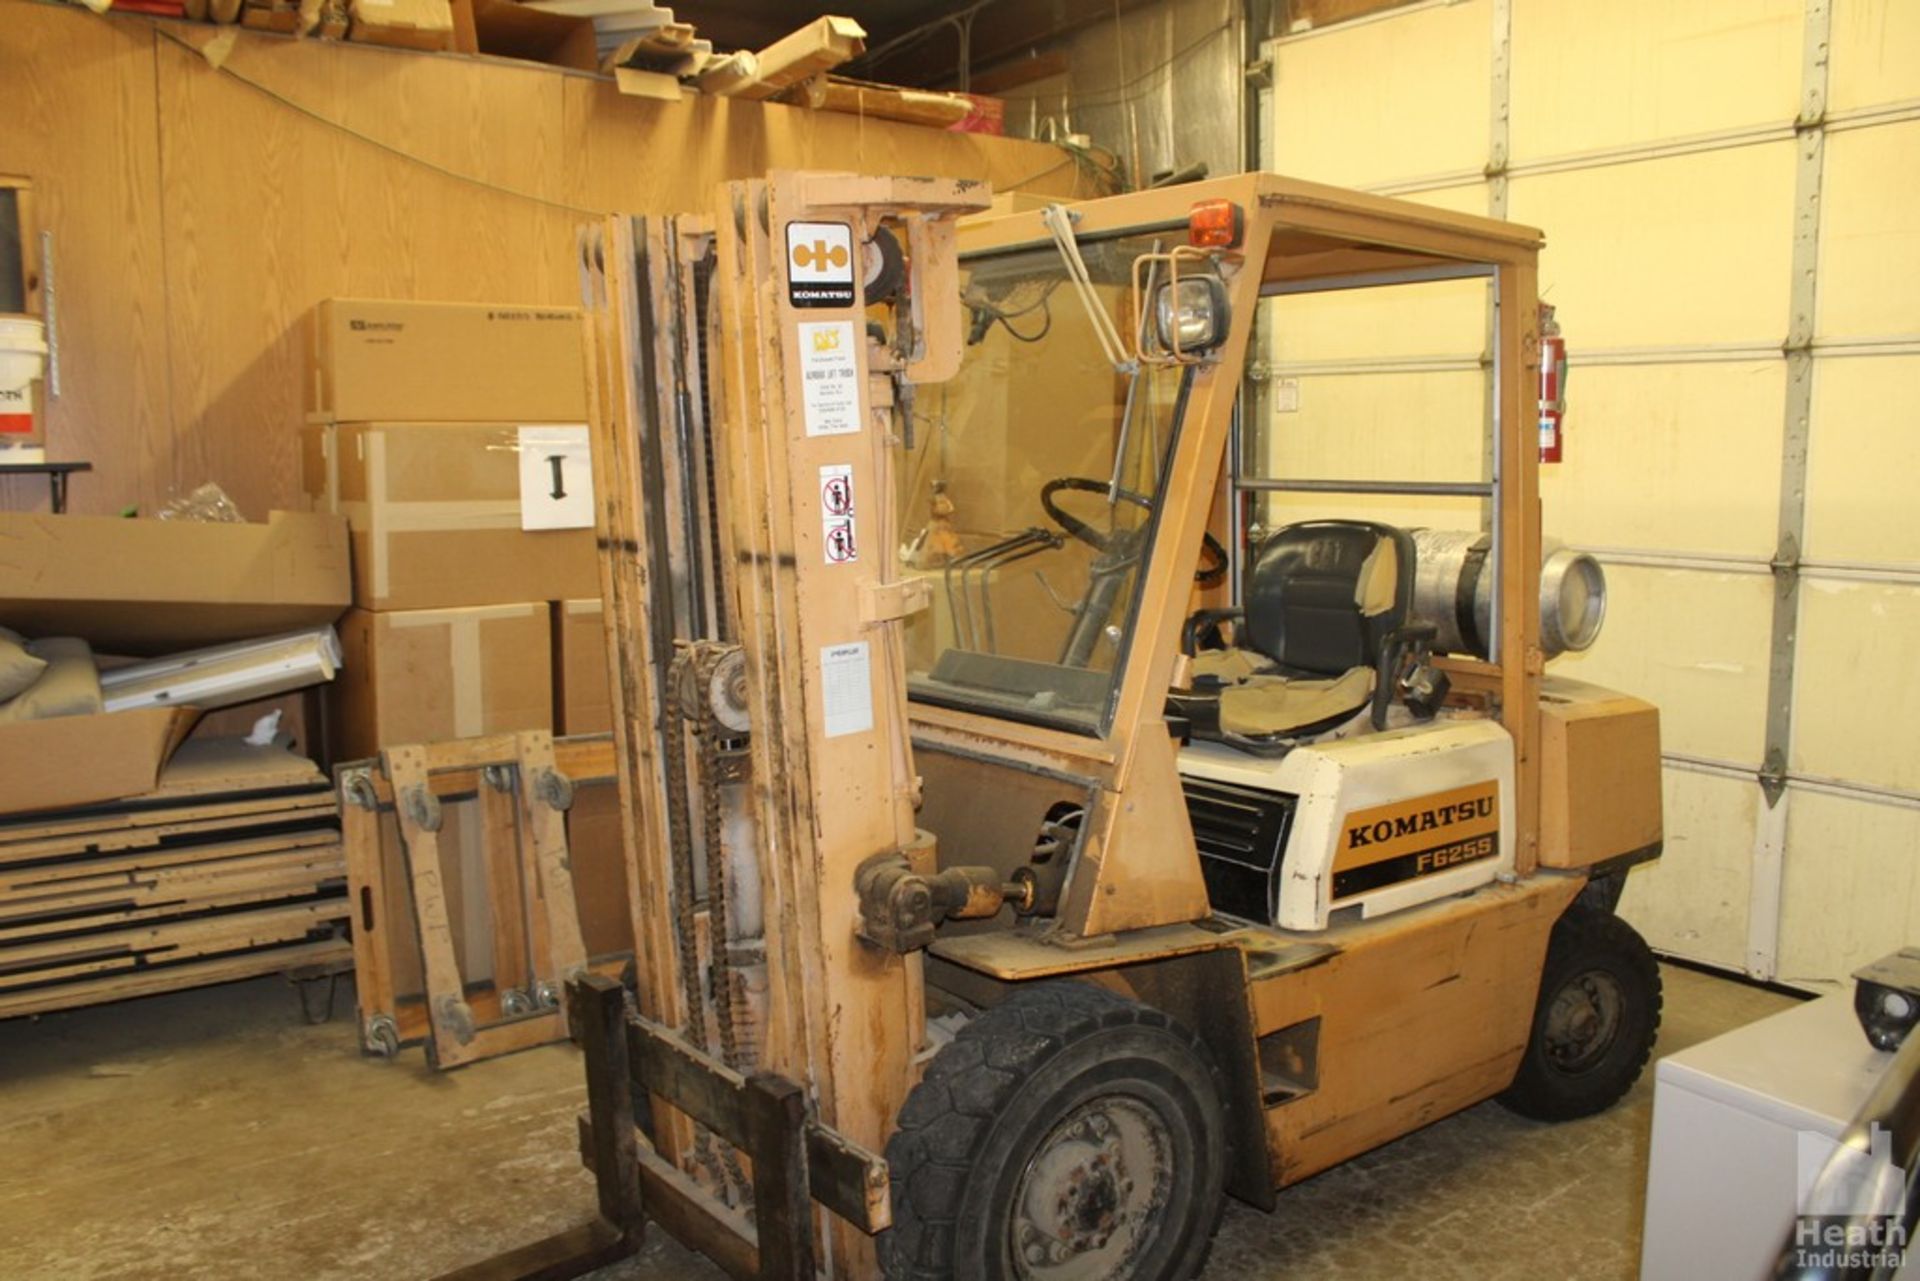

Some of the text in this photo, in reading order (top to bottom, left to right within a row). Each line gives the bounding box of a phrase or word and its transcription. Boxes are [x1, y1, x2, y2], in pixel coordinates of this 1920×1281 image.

[792, 290, 851, 299] KOMATSU
[1349, 796, 1494, 849] KOMATSU
[1417, 838, 1493, 871] FG25S
